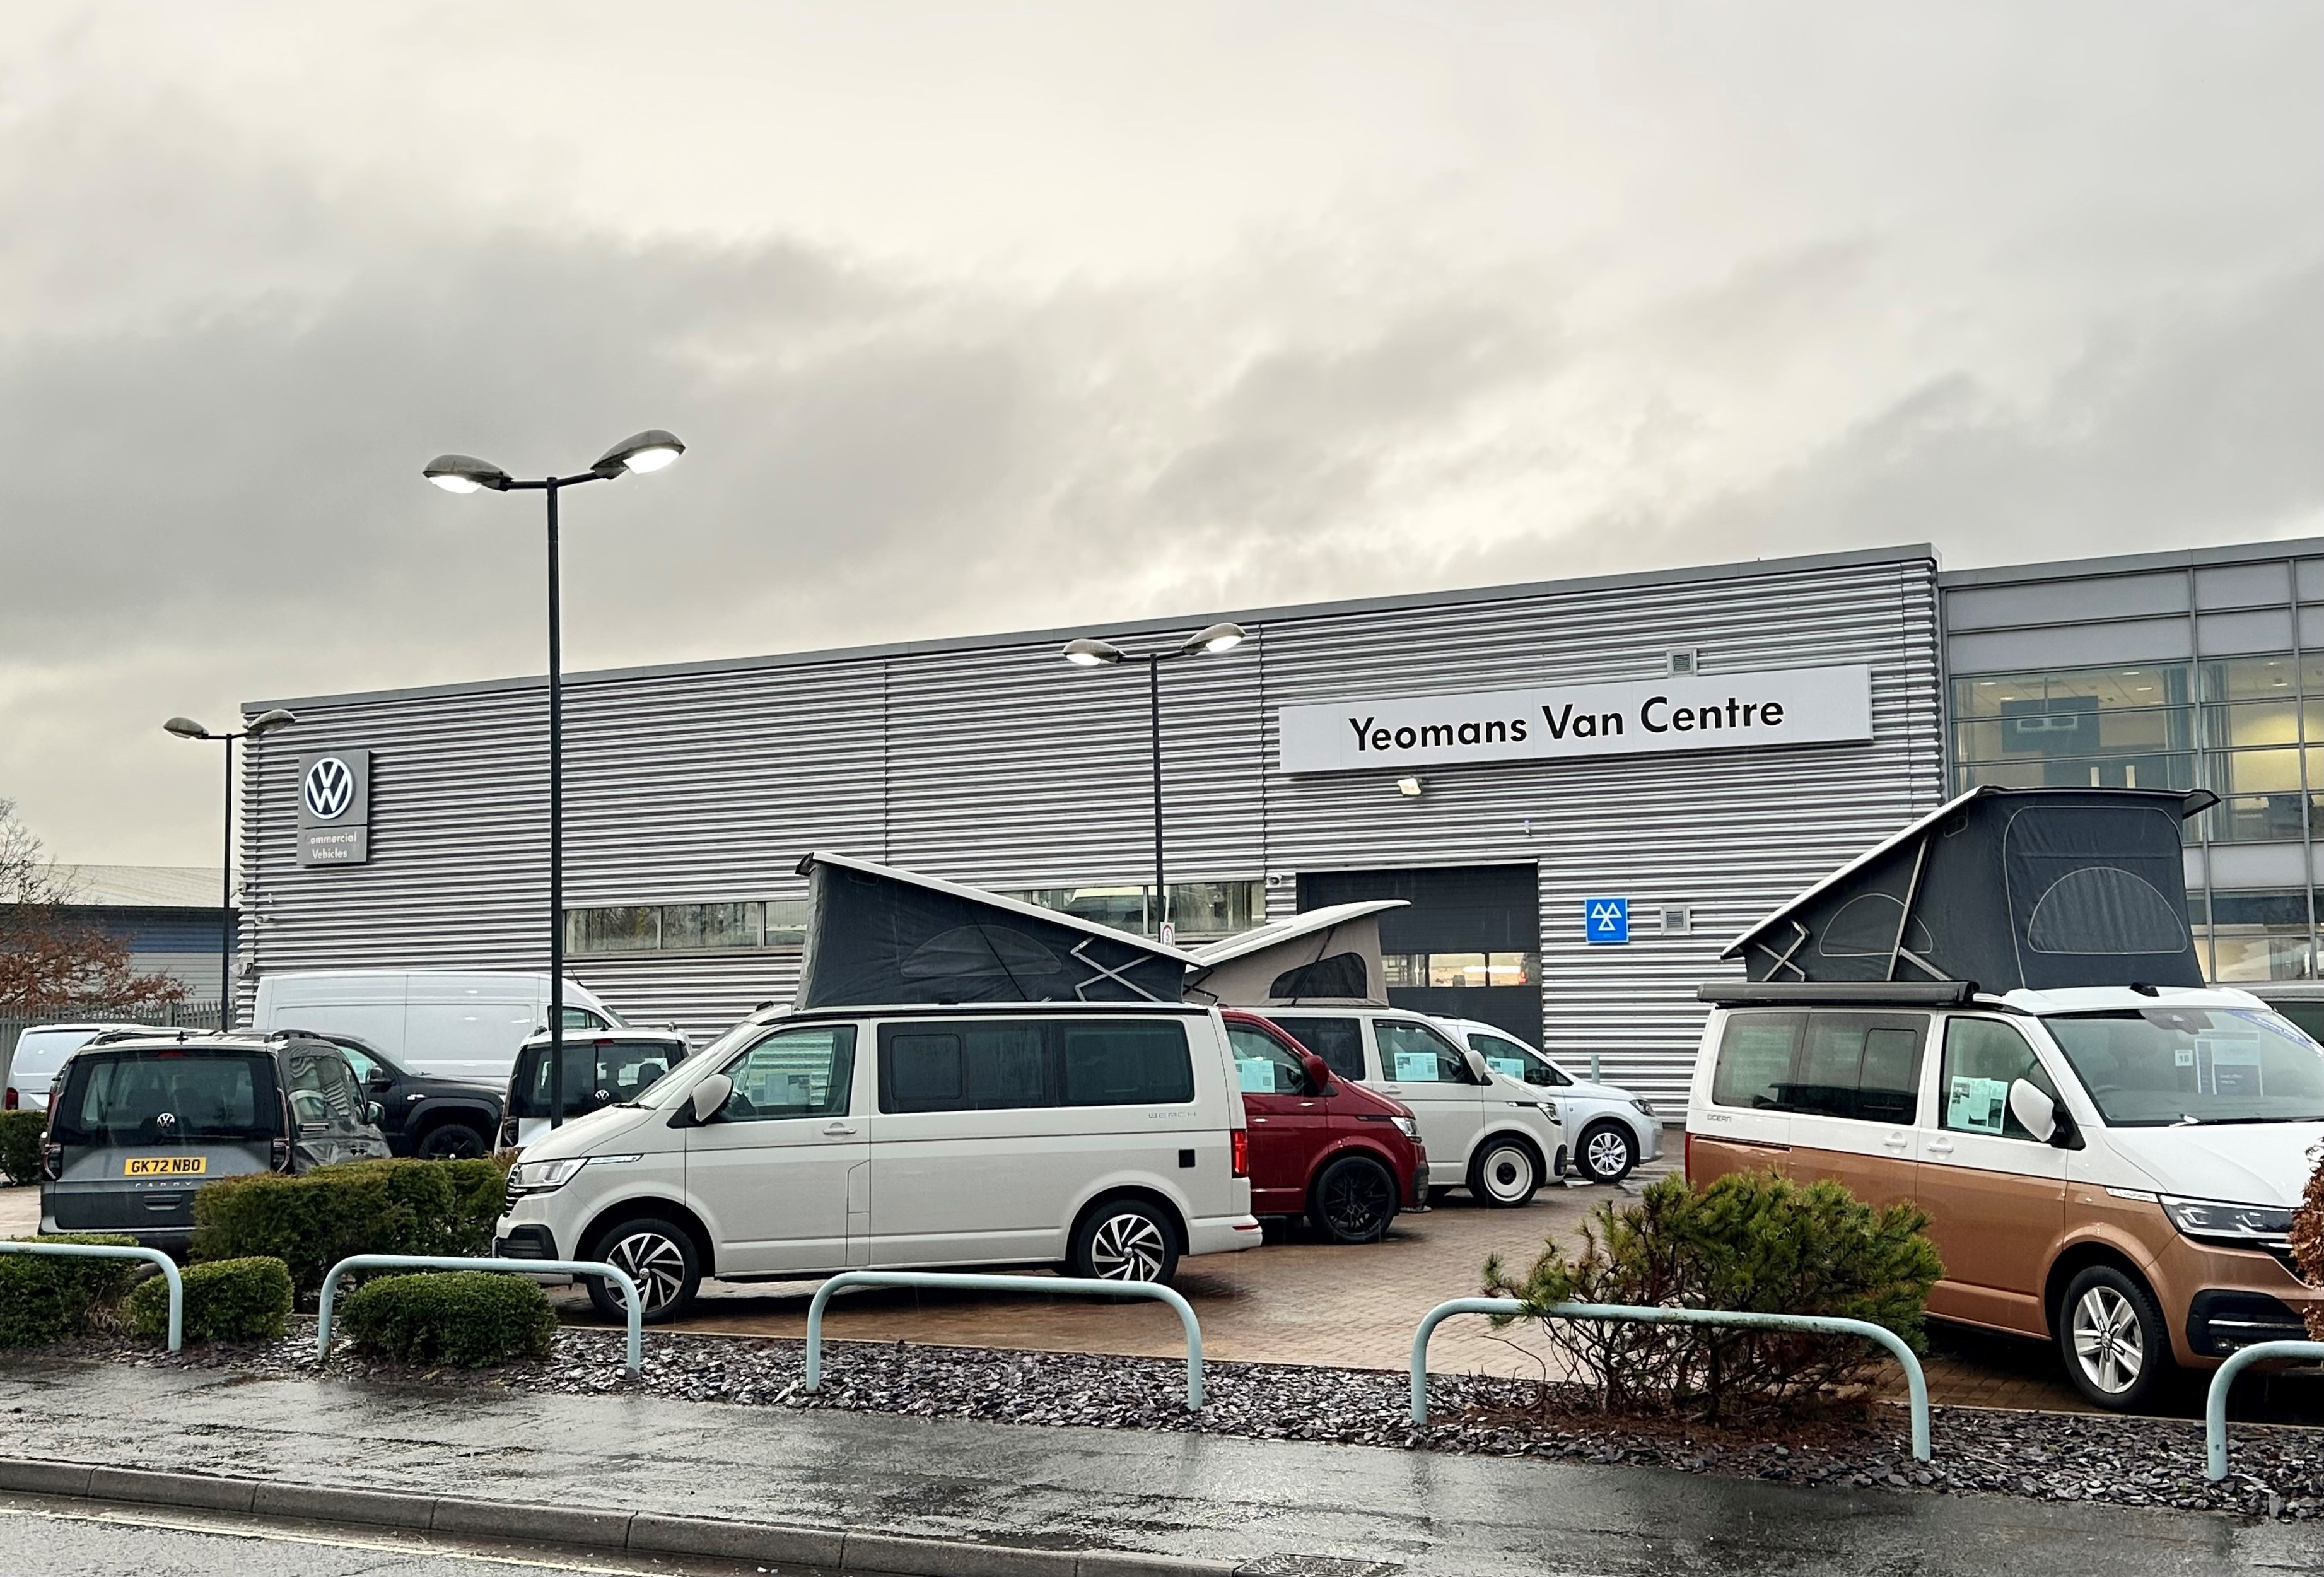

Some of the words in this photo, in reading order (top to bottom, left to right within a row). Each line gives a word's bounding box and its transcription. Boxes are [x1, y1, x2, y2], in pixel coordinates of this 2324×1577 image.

[1348, 717, 1527, 751] Yeomans
[1541, 703, 1624, 740] Van
[1640, 696, 1784, 734] Centre
[305, 758, 353, 819] VW
[305, 831, 357, 845] ommercial
[312, 847, 348, 859] Vehicles
[131, 1159, 169, 1173] GK72
[172, 1159, 201, 1172] NBO
